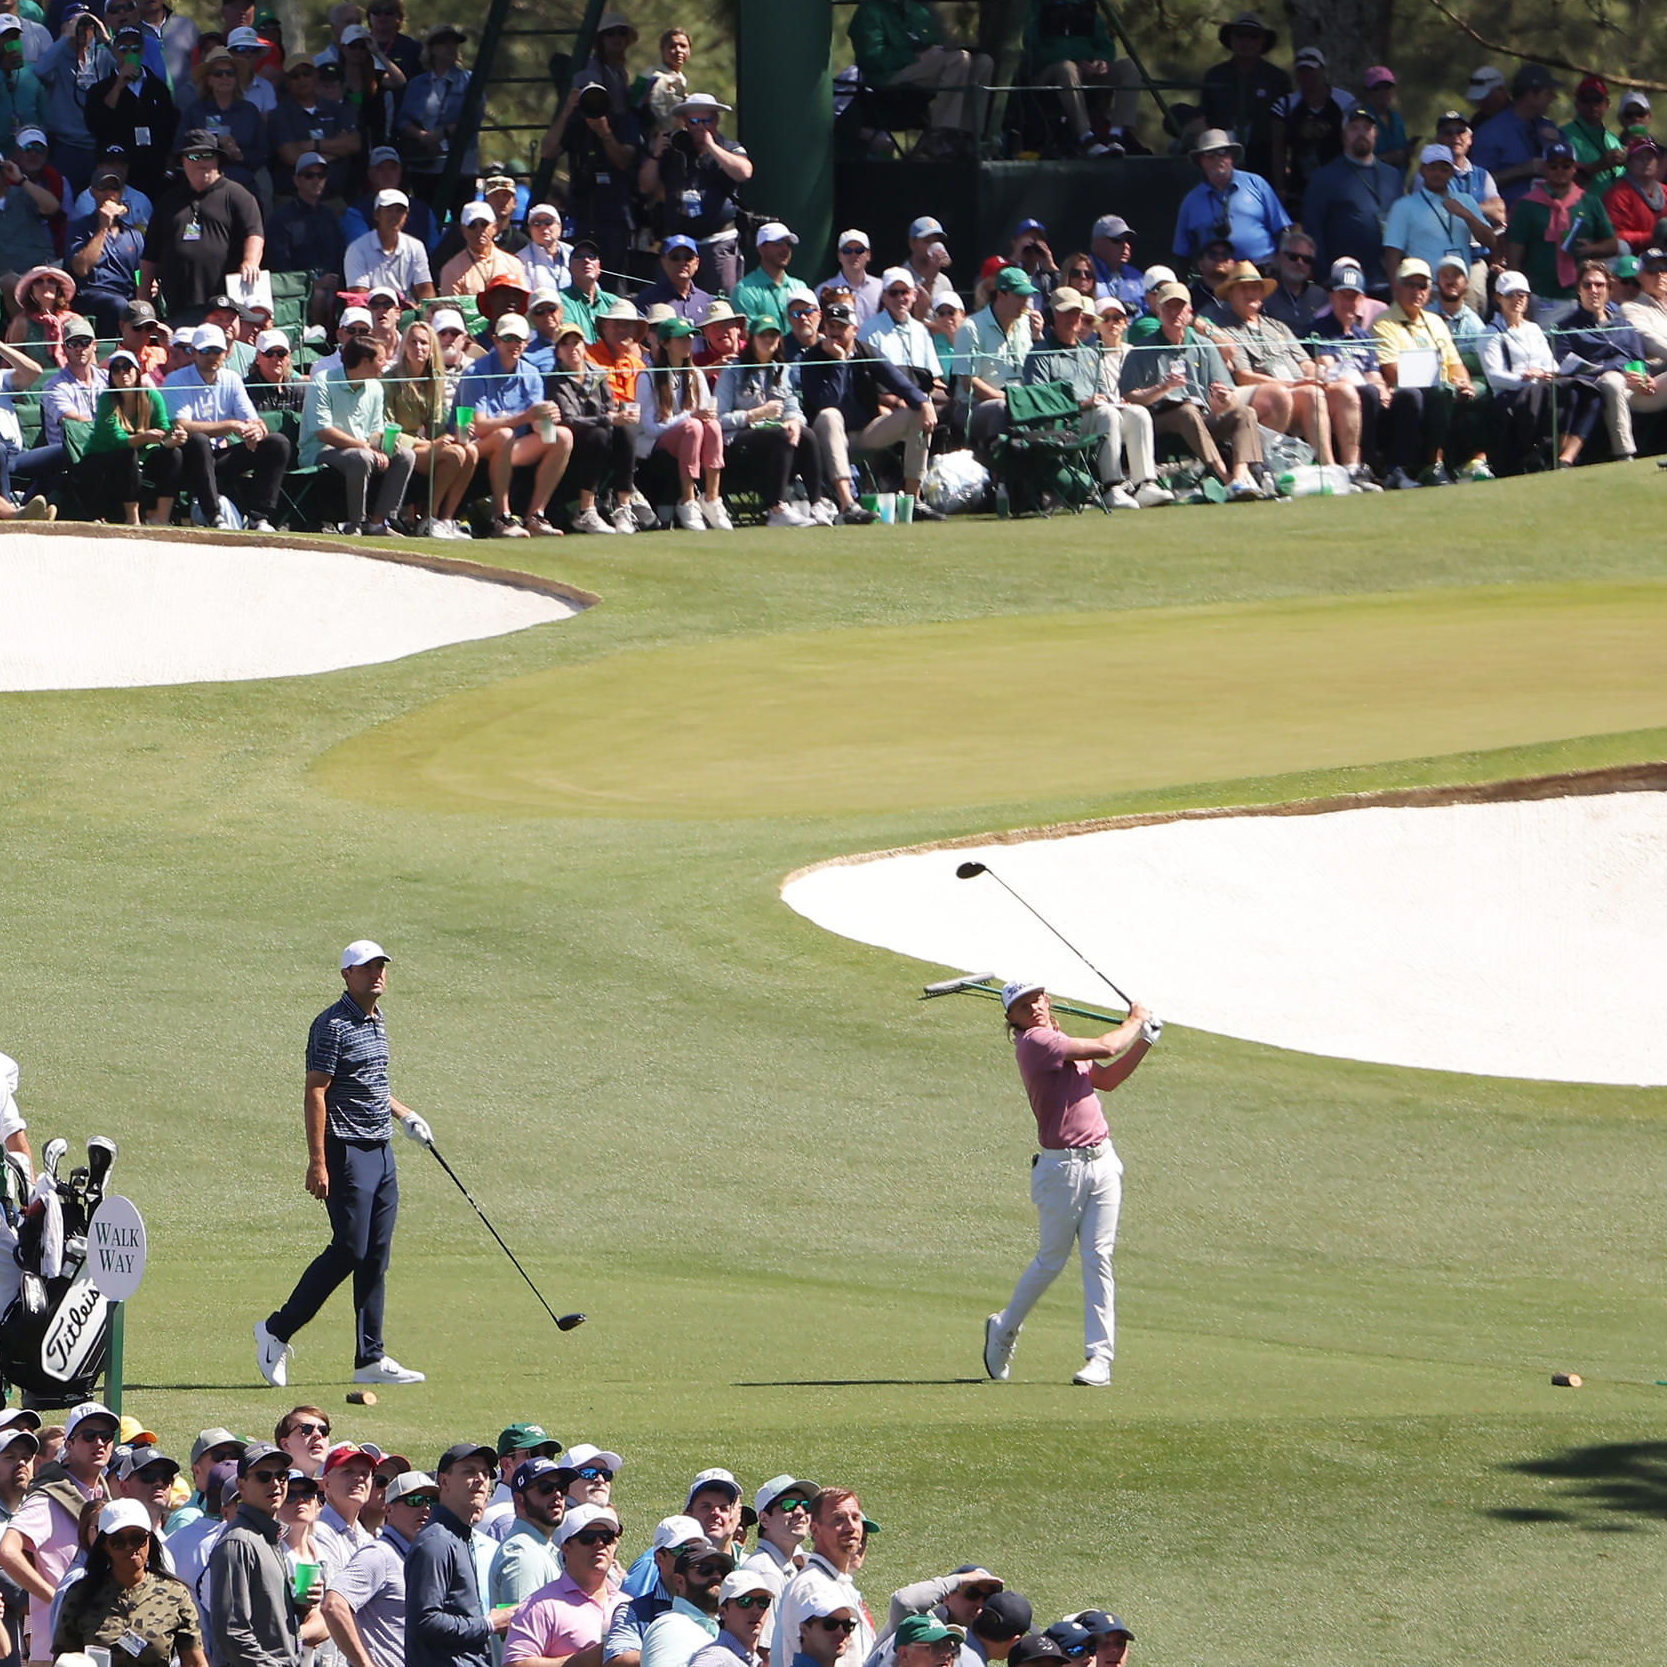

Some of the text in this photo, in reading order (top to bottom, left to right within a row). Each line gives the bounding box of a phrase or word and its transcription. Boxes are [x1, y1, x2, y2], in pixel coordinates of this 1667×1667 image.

[94, 1222, 140, 1248] WALK
[98, 1248, 135, 1274] WAY
[47, 1285, 101, 1373] Titleis
